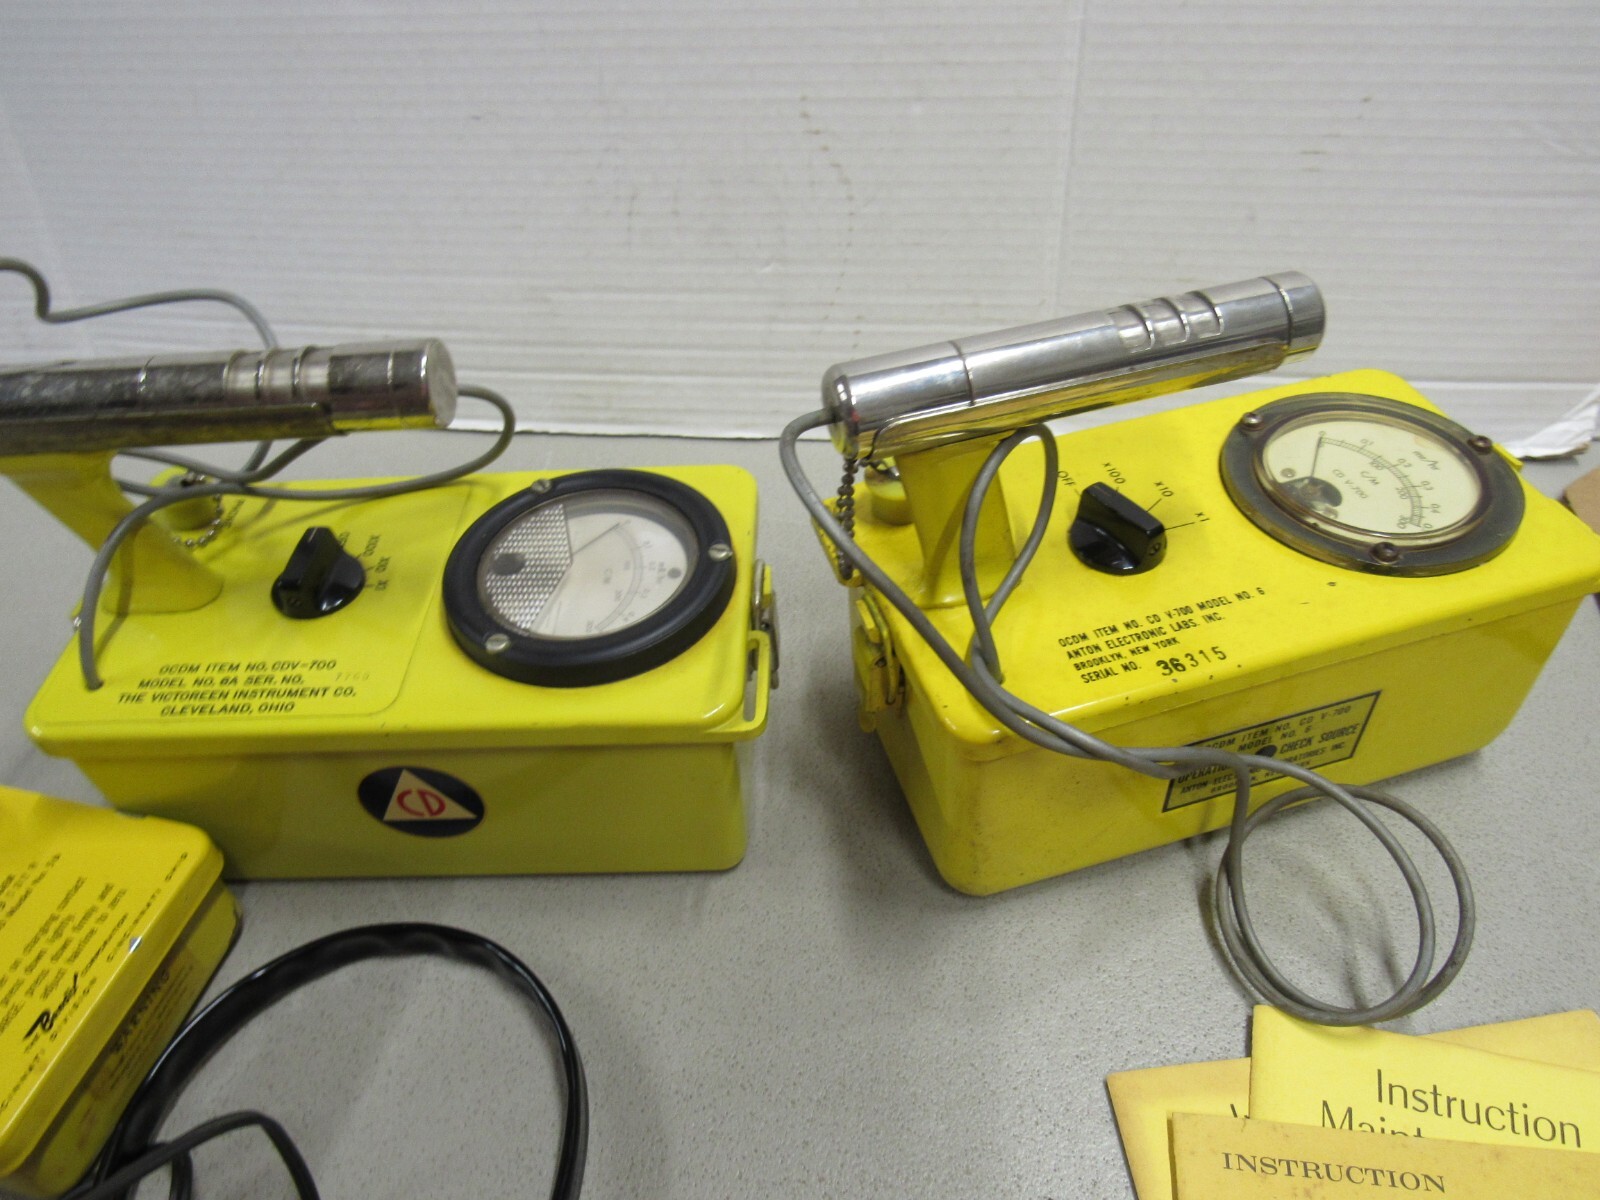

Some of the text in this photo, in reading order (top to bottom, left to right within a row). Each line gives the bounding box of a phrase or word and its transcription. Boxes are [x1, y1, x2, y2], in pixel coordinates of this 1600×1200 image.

[1057, 470, 1077, 487] OFF
[1058, 587, 1265, 648] OCDM ITEM NO. CD V-700 MODEL NO. 6
[1066, 644, 1103, 660] ANTON
[1105, 626, 1167, 650] ELECTRONIC
[1203, 611, 1226, 624] INC.
[1073, 637, 1181, 672] BROOKLYN, NEW YORK
[159, 662, 201, 676] OCDM
[205, 661, 240, 674] ITEM
[271, 659, 337, 672] CDV-700
[1080, 667, 1119, 684] SERIAL
[1122, 660, 1143, 673] NO.
[138, 677, 186, 690] MODEL
[243, 675, 277, 687] SER.
[118, 692, 146, 705] THE
[151, 689, 229, 703] VICTOREEN
[233, 686, 331, 701] INSTRUMENT
[161, 701, 296, 717] CLEVELAND, OHIO
[1237, 735, 1273, 752] MODEL
[1241, 728, 1270, 743] ITEM
[1280, 735, 1314, 754] CHECK
[1318, 722, 1361, 744] SOURCE
[396, 788, 447, 817] CD
[1376, 1068, 1582, 1148] Instruction
[1222, 1152, 1447, 1194] INSTRUCTION
